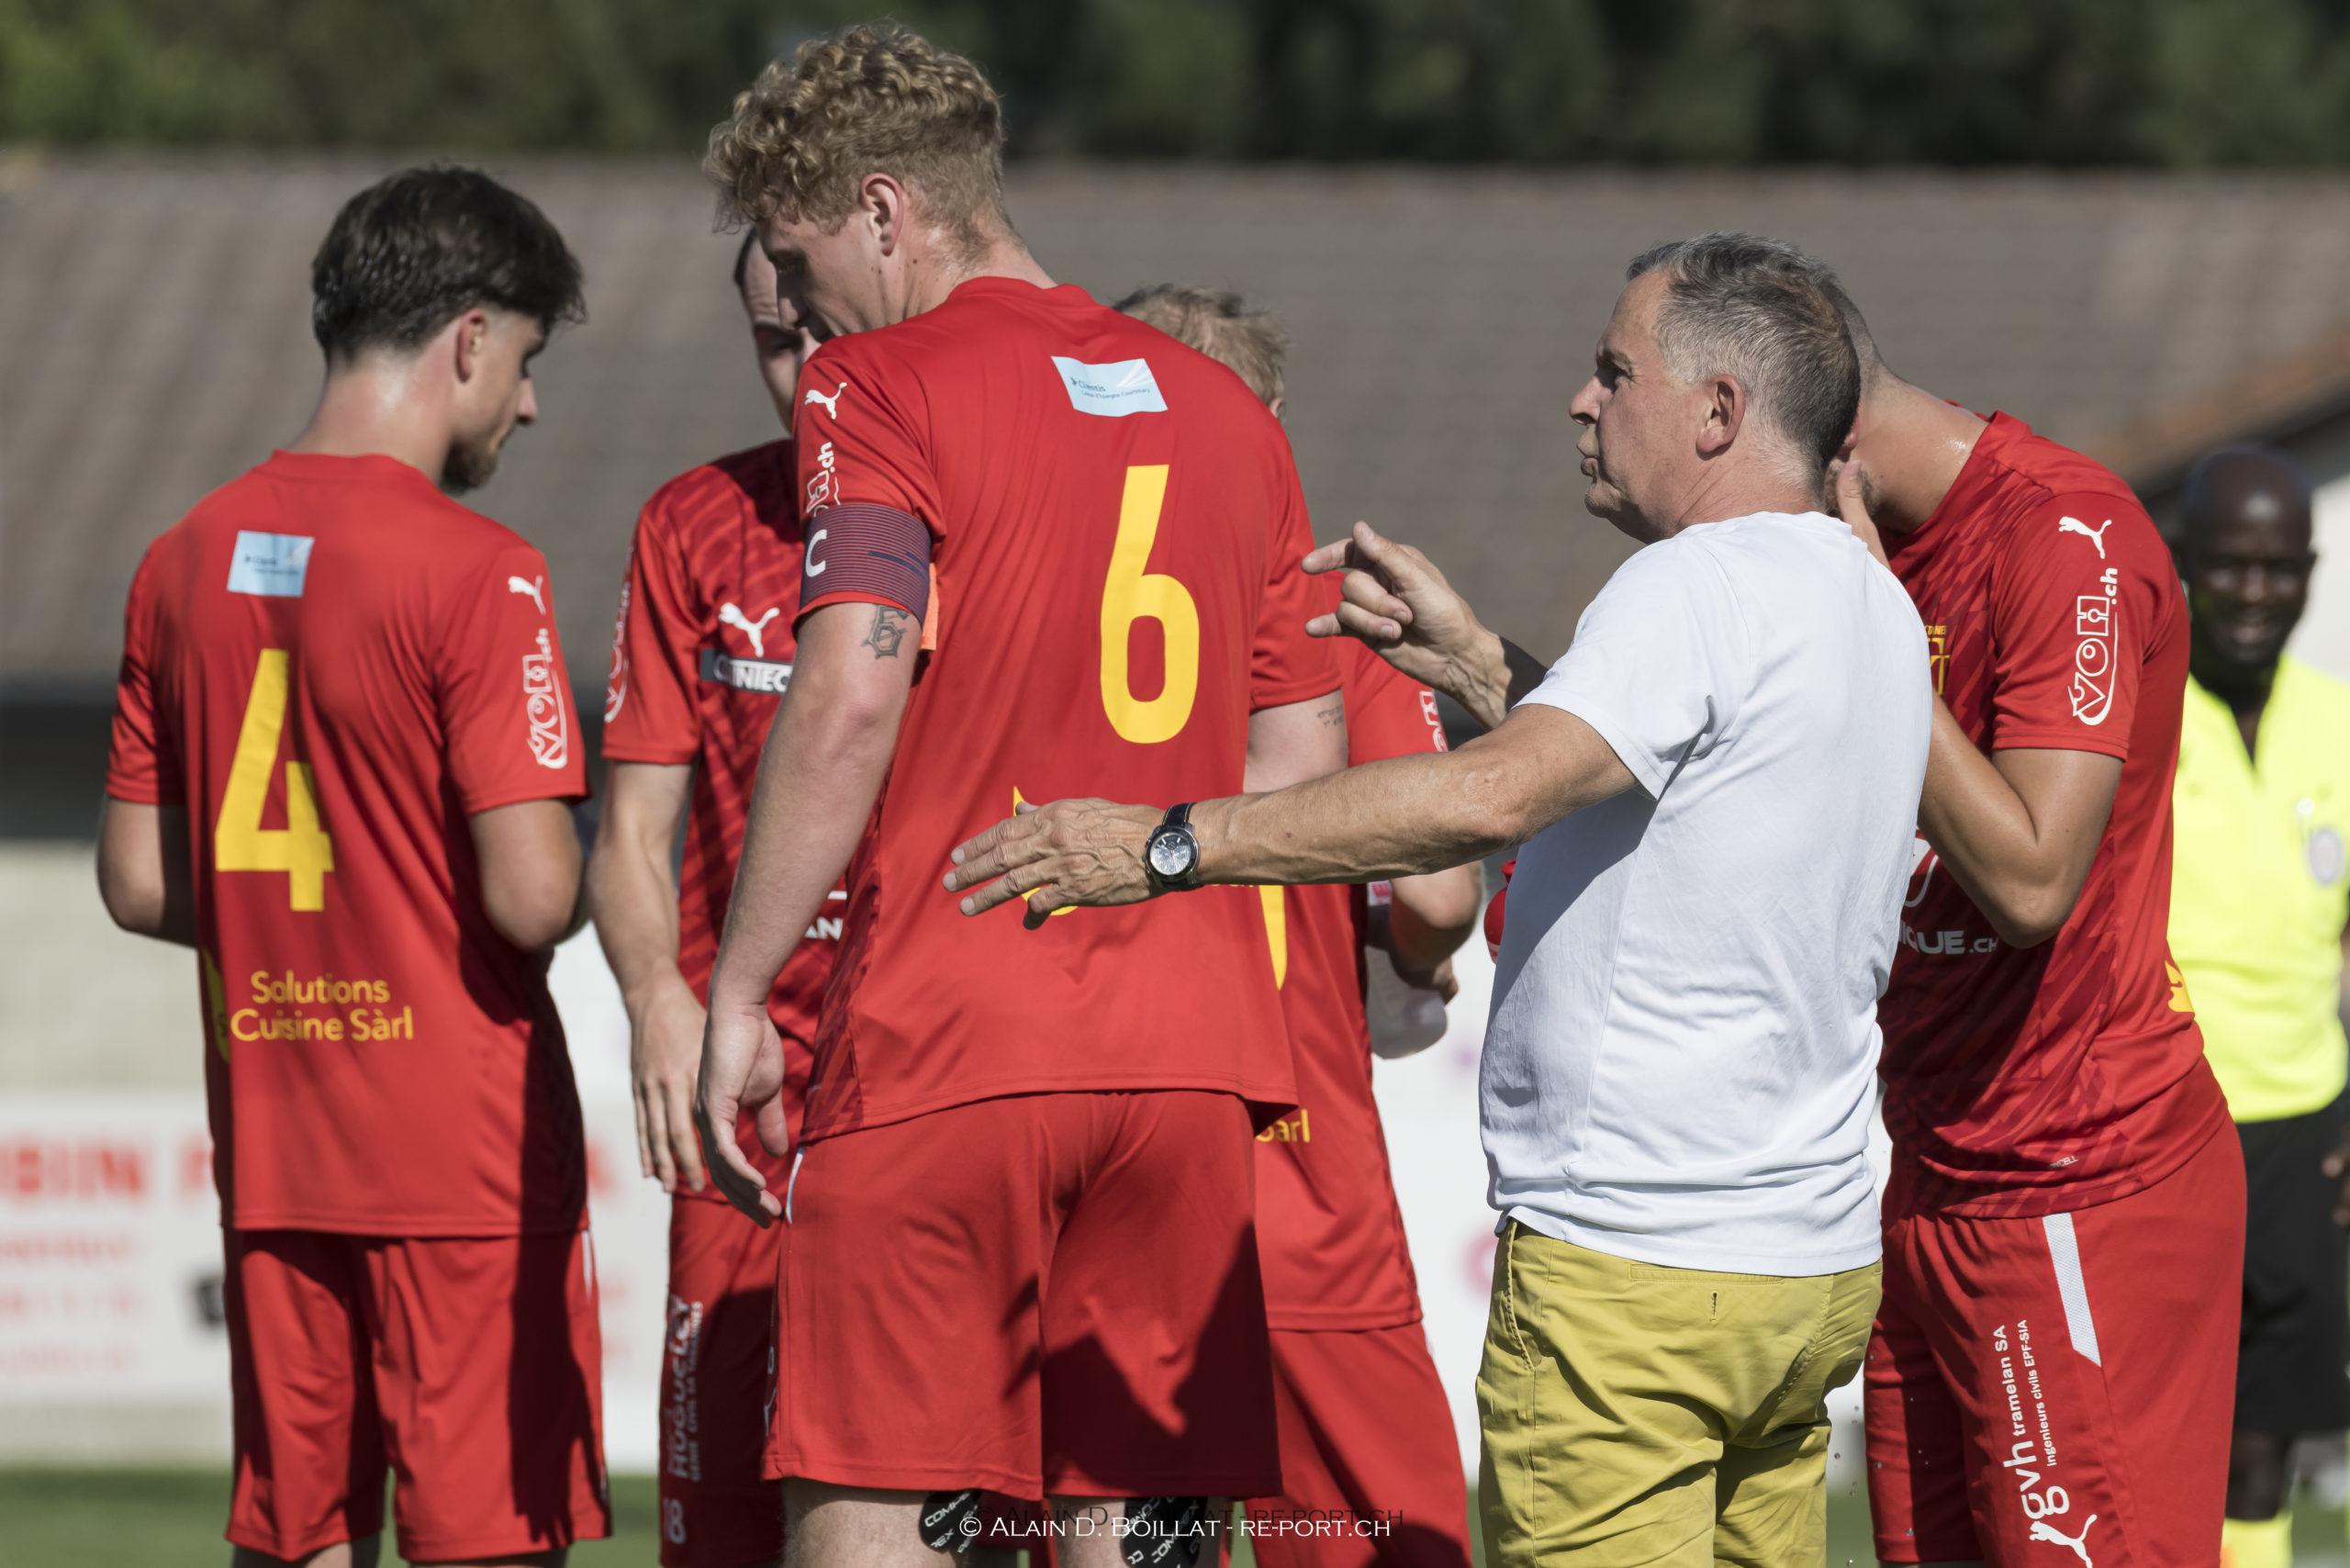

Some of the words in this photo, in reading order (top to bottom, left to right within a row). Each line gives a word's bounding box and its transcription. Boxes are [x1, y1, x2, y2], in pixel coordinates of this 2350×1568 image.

[804, 529, 827, 577] C
[1101, 464, 1200, 745] 6
[214, 648, 334, 912] 4
[250, 969, 391, 1004] Solutions
[229, 1007, 345, 1042] Cuisine
[349, 1004, 414, 1042] Sàrl
[1993, 1324, 2009, 1352] SA
[2017, 1319, 2036, 1368] EPF-SIA
[1999, 1356, 2026, 1438] tramelan
[2028, 1369, 2042, 1400] civils
[2002, 1439, 2070, 1520] gvh
